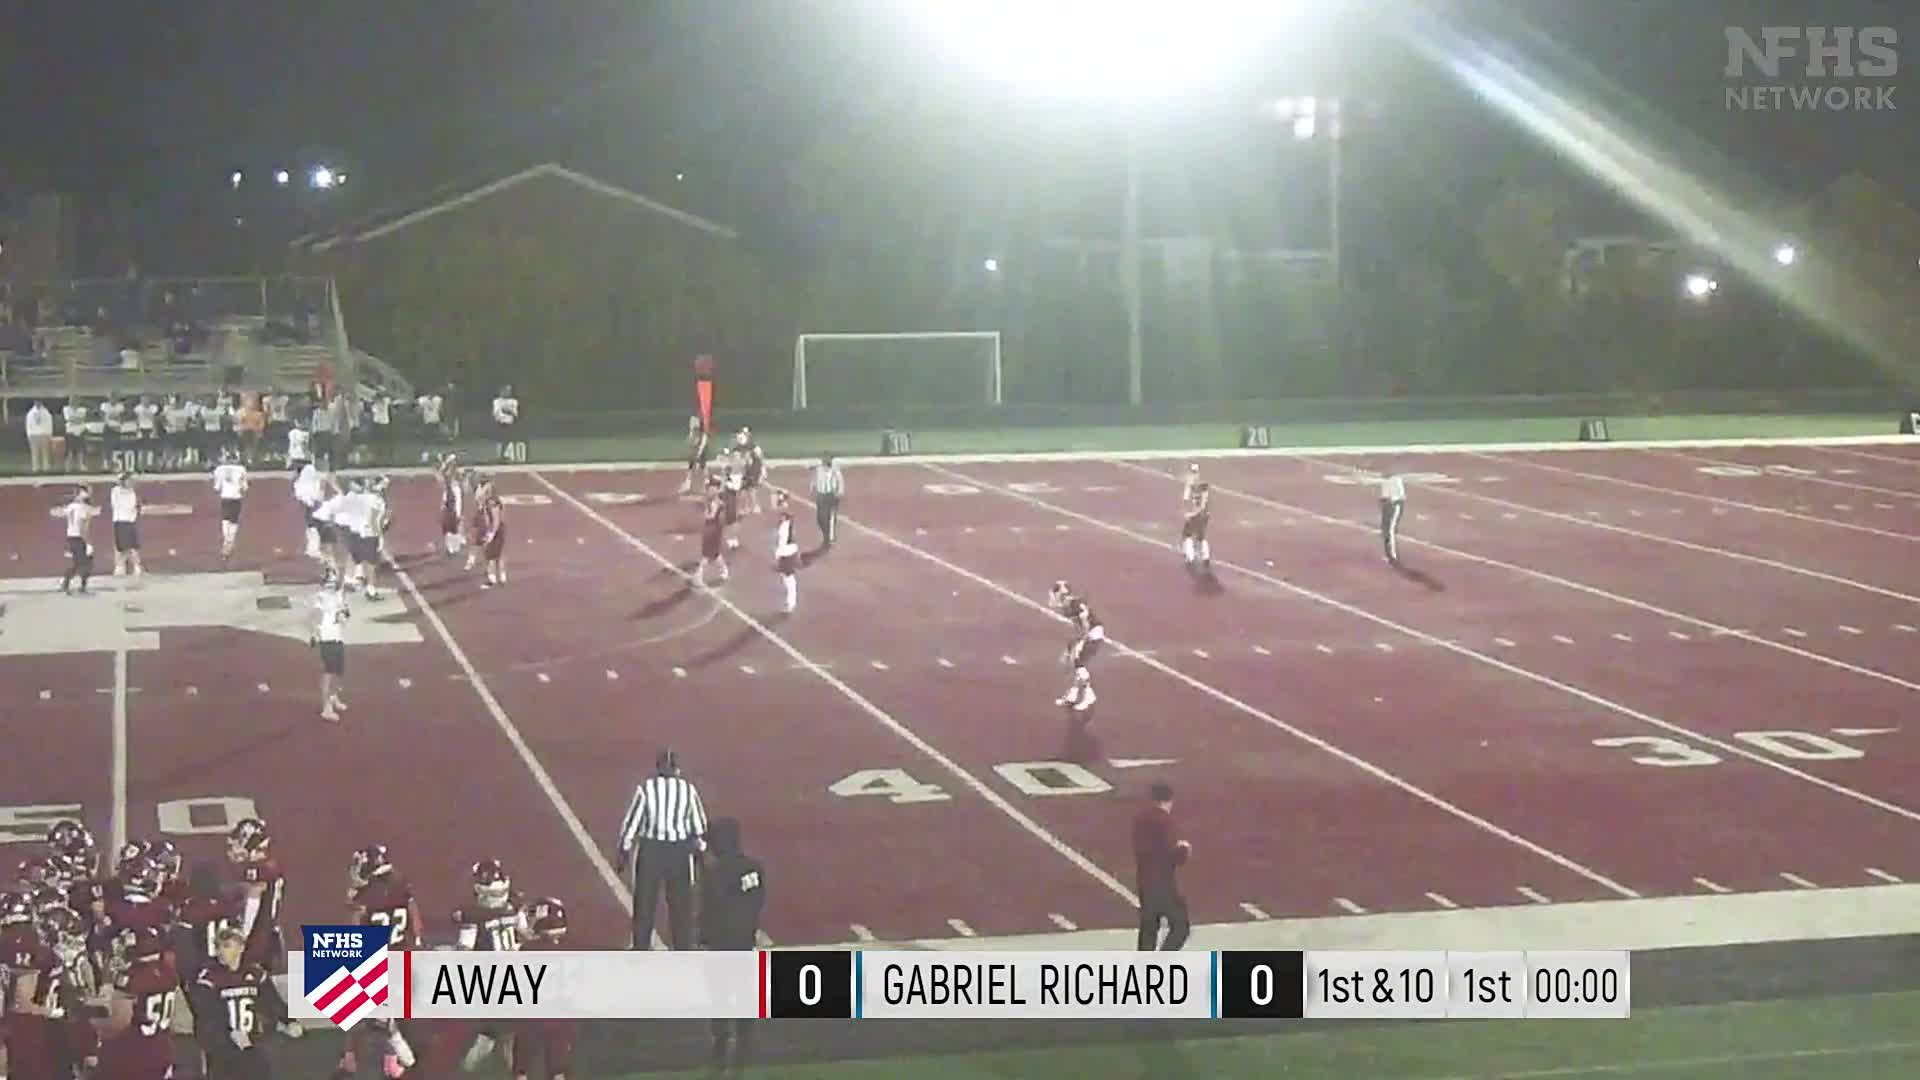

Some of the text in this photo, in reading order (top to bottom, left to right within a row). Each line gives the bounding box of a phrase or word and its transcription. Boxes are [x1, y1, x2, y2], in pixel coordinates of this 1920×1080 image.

[1247, 426, 1269, 447] 20
[112, 450, 136, 472] 50
[503, 442, 527, 462] 40
[828, 760, 1113, 804] 40
[227, 997, 255, 1033] 16
